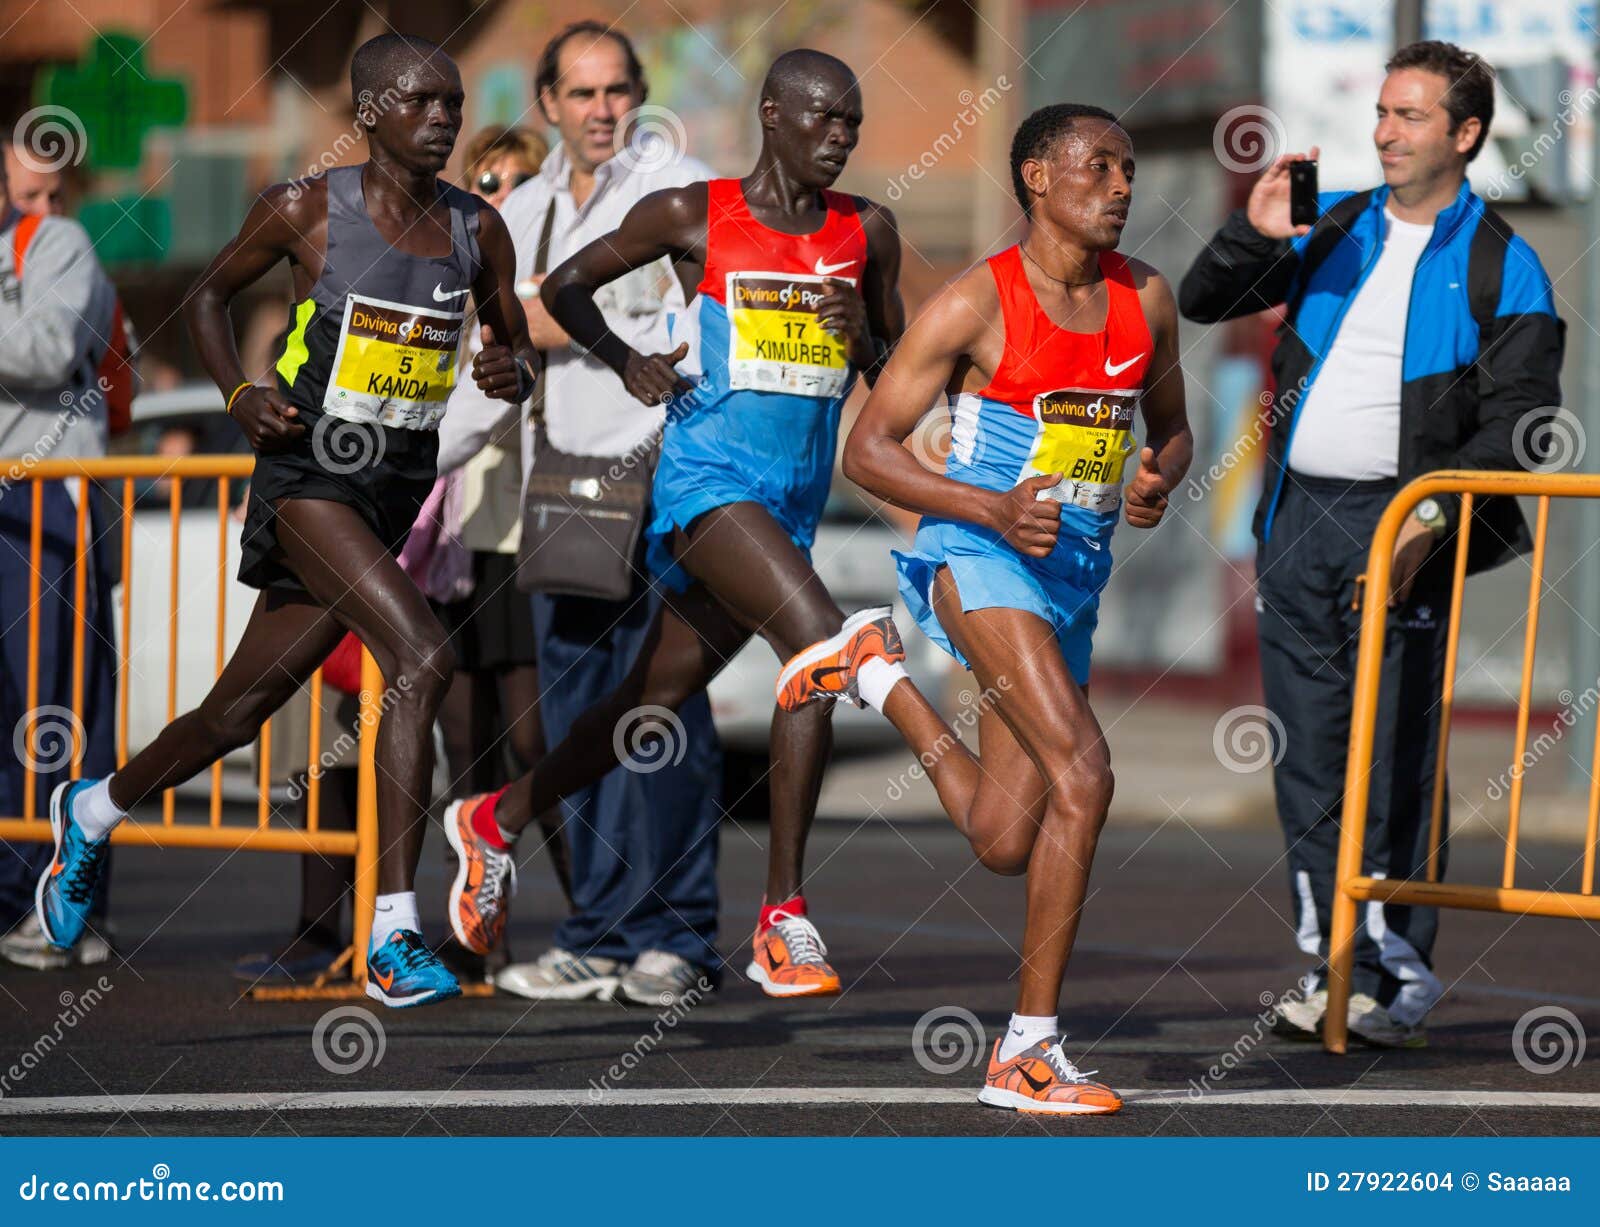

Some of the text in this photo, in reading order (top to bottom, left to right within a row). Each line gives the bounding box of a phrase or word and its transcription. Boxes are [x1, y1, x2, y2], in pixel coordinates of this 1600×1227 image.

[735, 287, 778, 302] Divina
[352, 312, 397, 334] Divina
[784, 322, 806, 339] 17
[756, 339, 831, 366] KIMURER
[399, 357, 413, 374] 5
[367, 372, 428, 400] KANDA
[1043, 399, 1085, 417] Divina
[1094, 439, 1107, 457] 3
[1071, 458, 1113, 482] BIRU
